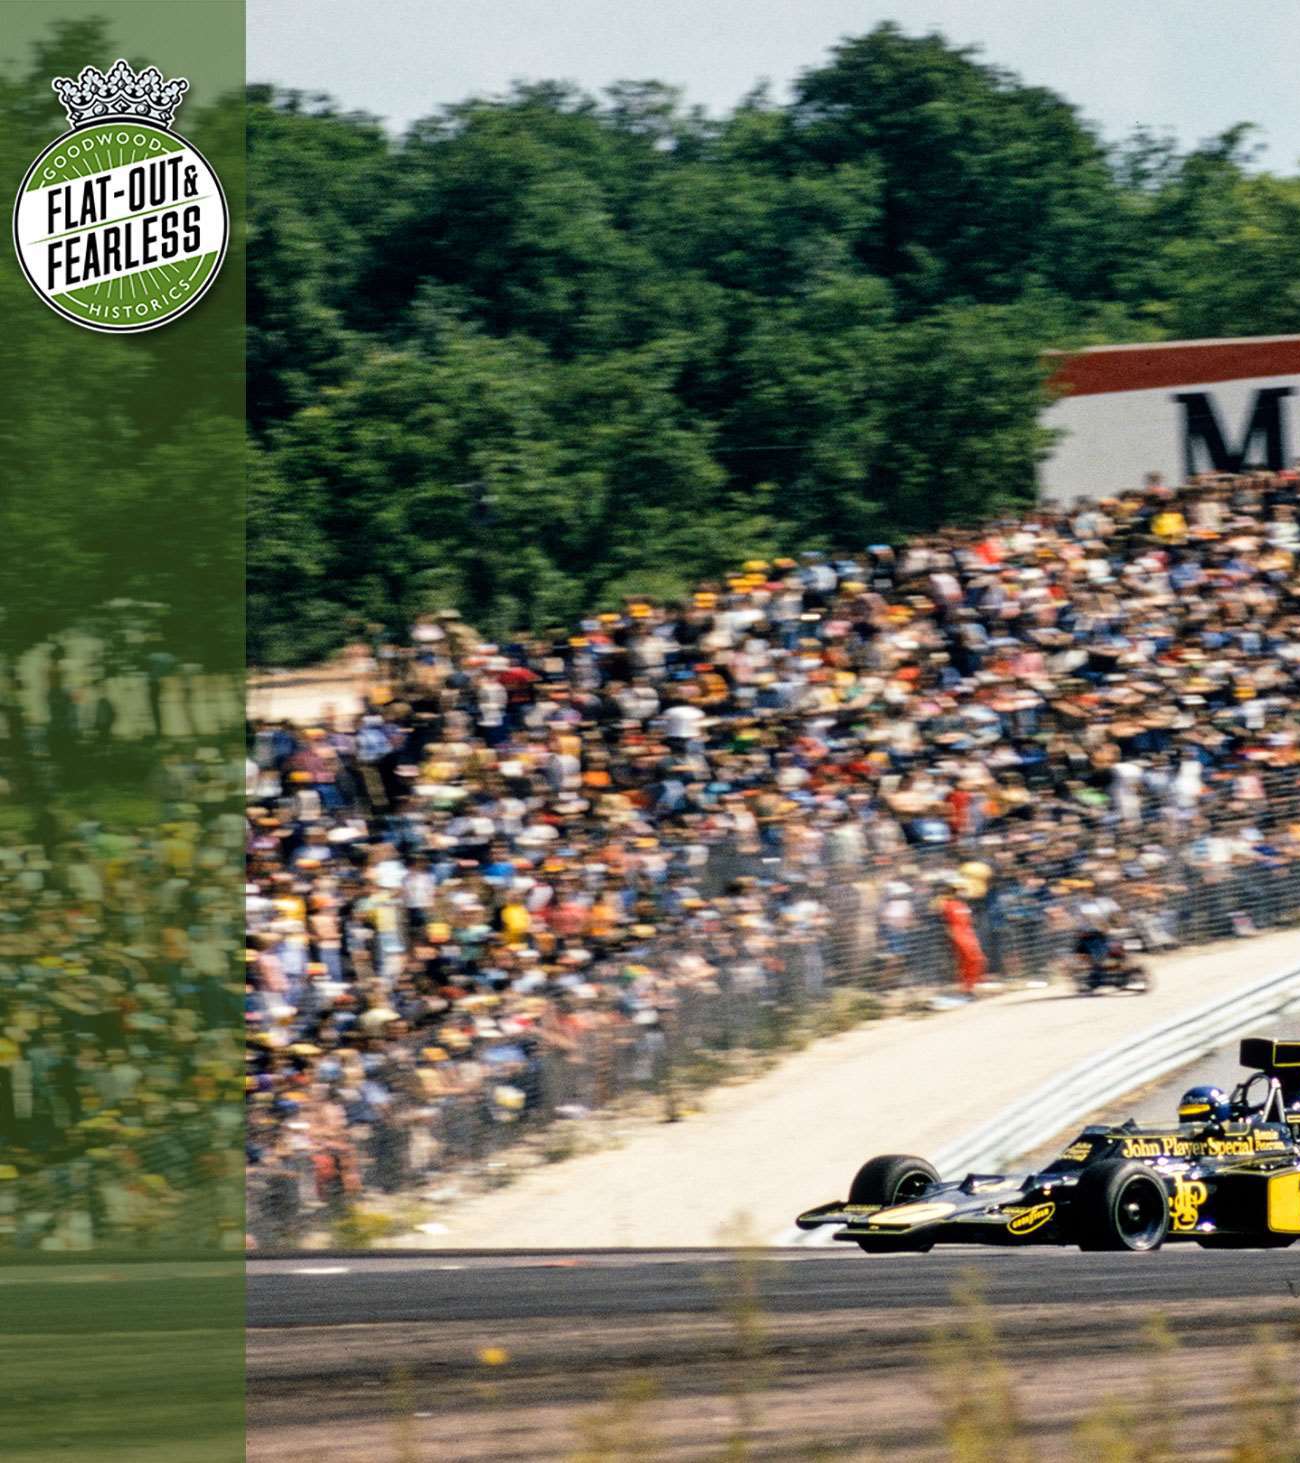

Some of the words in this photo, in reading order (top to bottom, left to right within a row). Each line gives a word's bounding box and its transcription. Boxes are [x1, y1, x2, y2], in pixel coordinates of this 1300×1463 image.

[1123, 1138, 1161, 1158] John
[1161, 1136, 1207, 1158] Player
[1207, 1135, 1256, 1157] Special
